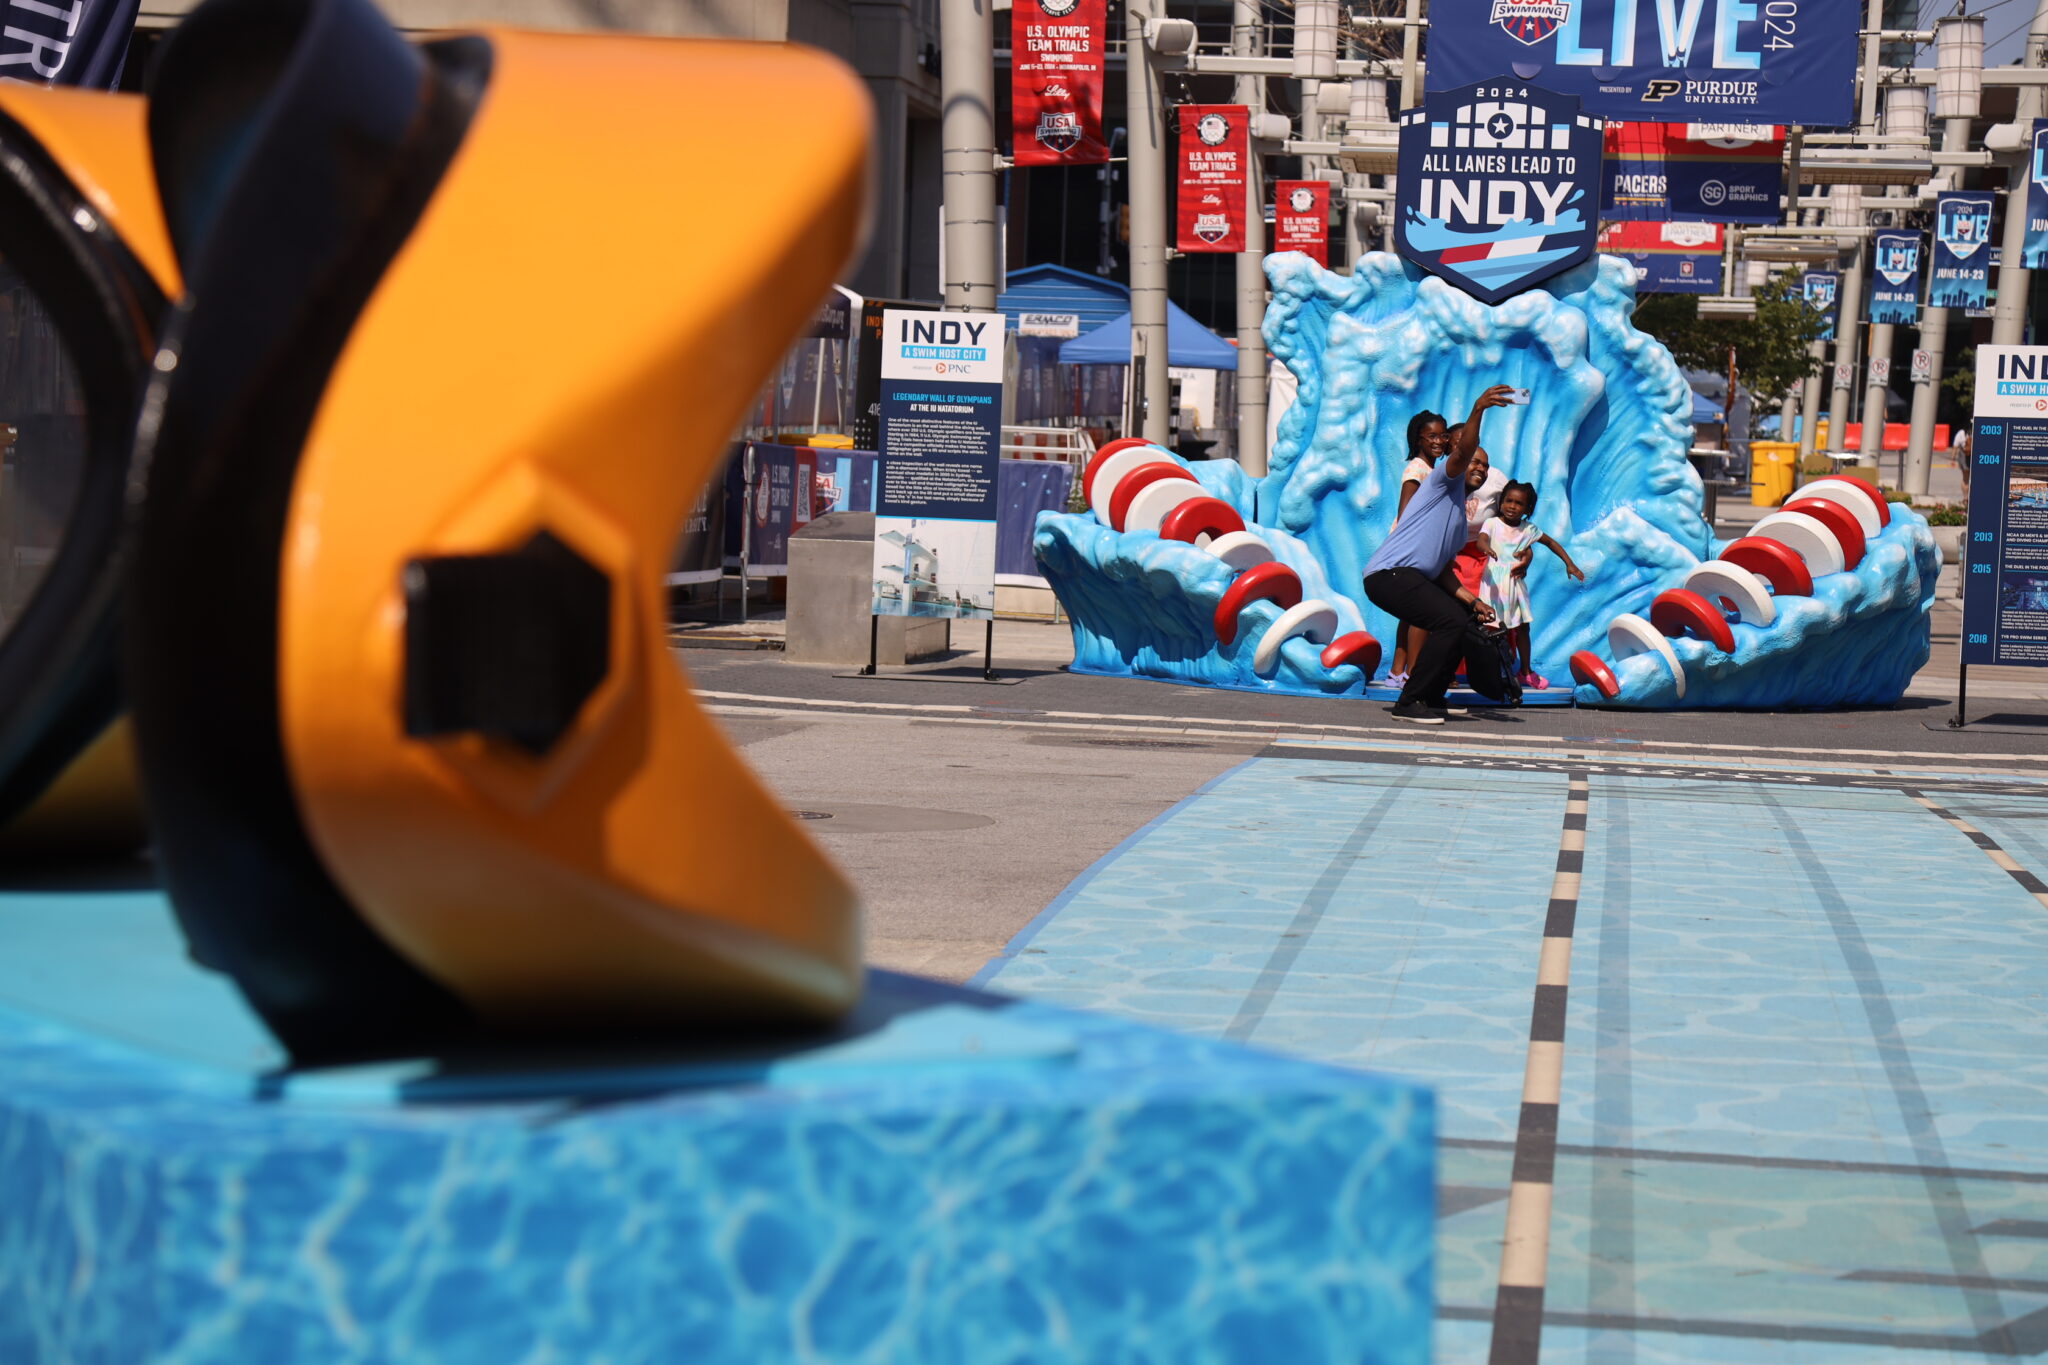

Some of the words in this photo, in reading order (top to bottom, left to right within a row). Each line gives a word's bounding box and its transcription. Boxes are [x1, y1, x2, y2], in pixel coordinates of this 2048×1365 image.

[1499, 5, 1562, 16] SWIMMING
[1027, 25, 1044, 37] U.S.
[1047, 26, 1090, 38] OLYMPIC
[1556, 0, 1761, 69] LIVE
[1027, 39, 1052, 52] TEAM
[1054, 40, 1089, 52] TRIALS
[1040, 53, 1073, 62] SWIMMING
[1476, 88, 1528, 98] 2024
[1685, 80, 1758, 95] PURDUE
[1684, 96, 1757, 104] UNIVERSITY
[1046, 117, 1070, 128] USA
[1701, 123, 1759, 134] PARTNER
[1205, 152, 1237, 161] OLYMPIC
[1189, 161, 1209, 171] TEAM
[1211, 161, 1237, 171] TRIALS
[1422, 154, 1450, 171] ALL
[1456, 155, 1506, 173] LANES
[1511, 156, 1550, 174] LEAD
[1557, 157, 1576, 174] TO
[1614, 174, 1667, 193] PACERS
[1728, 185, 1755, 193] SPORT
[1704, 186, 1722, 198] SG
[1728, 193, 1768, 201] GRAPHICS
[1419, 178, 1575, 226] INDY
[1957, 206, 1973, 214] 2024
[1202, 217, 1221, 225] USA
[1940, 214, 1988, 240] LIVE
[1936, 268, 1957, 279] JUNE
[1960, 269, 1984, 280] 14-23
[901, 319, 987, 345] INDY
[904, 348, 911, 357] A
[912, 348, 936, 358] SWIM
[939, 349, 961, 358] HOST
[963, 349, 983, 359] CITY
[948, 364, 971, 374] PNC
[2001, 384, 2007, 394] A
[2010, 384, 2037, 394] SWIM
[893, 392, 929, 401] LEGENDARY
[929, 394, 946, 402] WALL
[947, 395, 955, 403] OF
[957, 396, 992, 404] OLYMPIANS
[910, 403, 917, 411] AT
[918, 404, 929, 412] THE
[930, 404, 937, 412] IU
[937, 405, 974, 414] NATATORIUM
[1980, 425, 2002, 435] 2003
[1979, 454, 2000, 464] 2004
[1974, 531, 1993, 542] 2013
[1972, 563, 1991, 573] 2015
[1968, 633, 1988, 644] 2018
